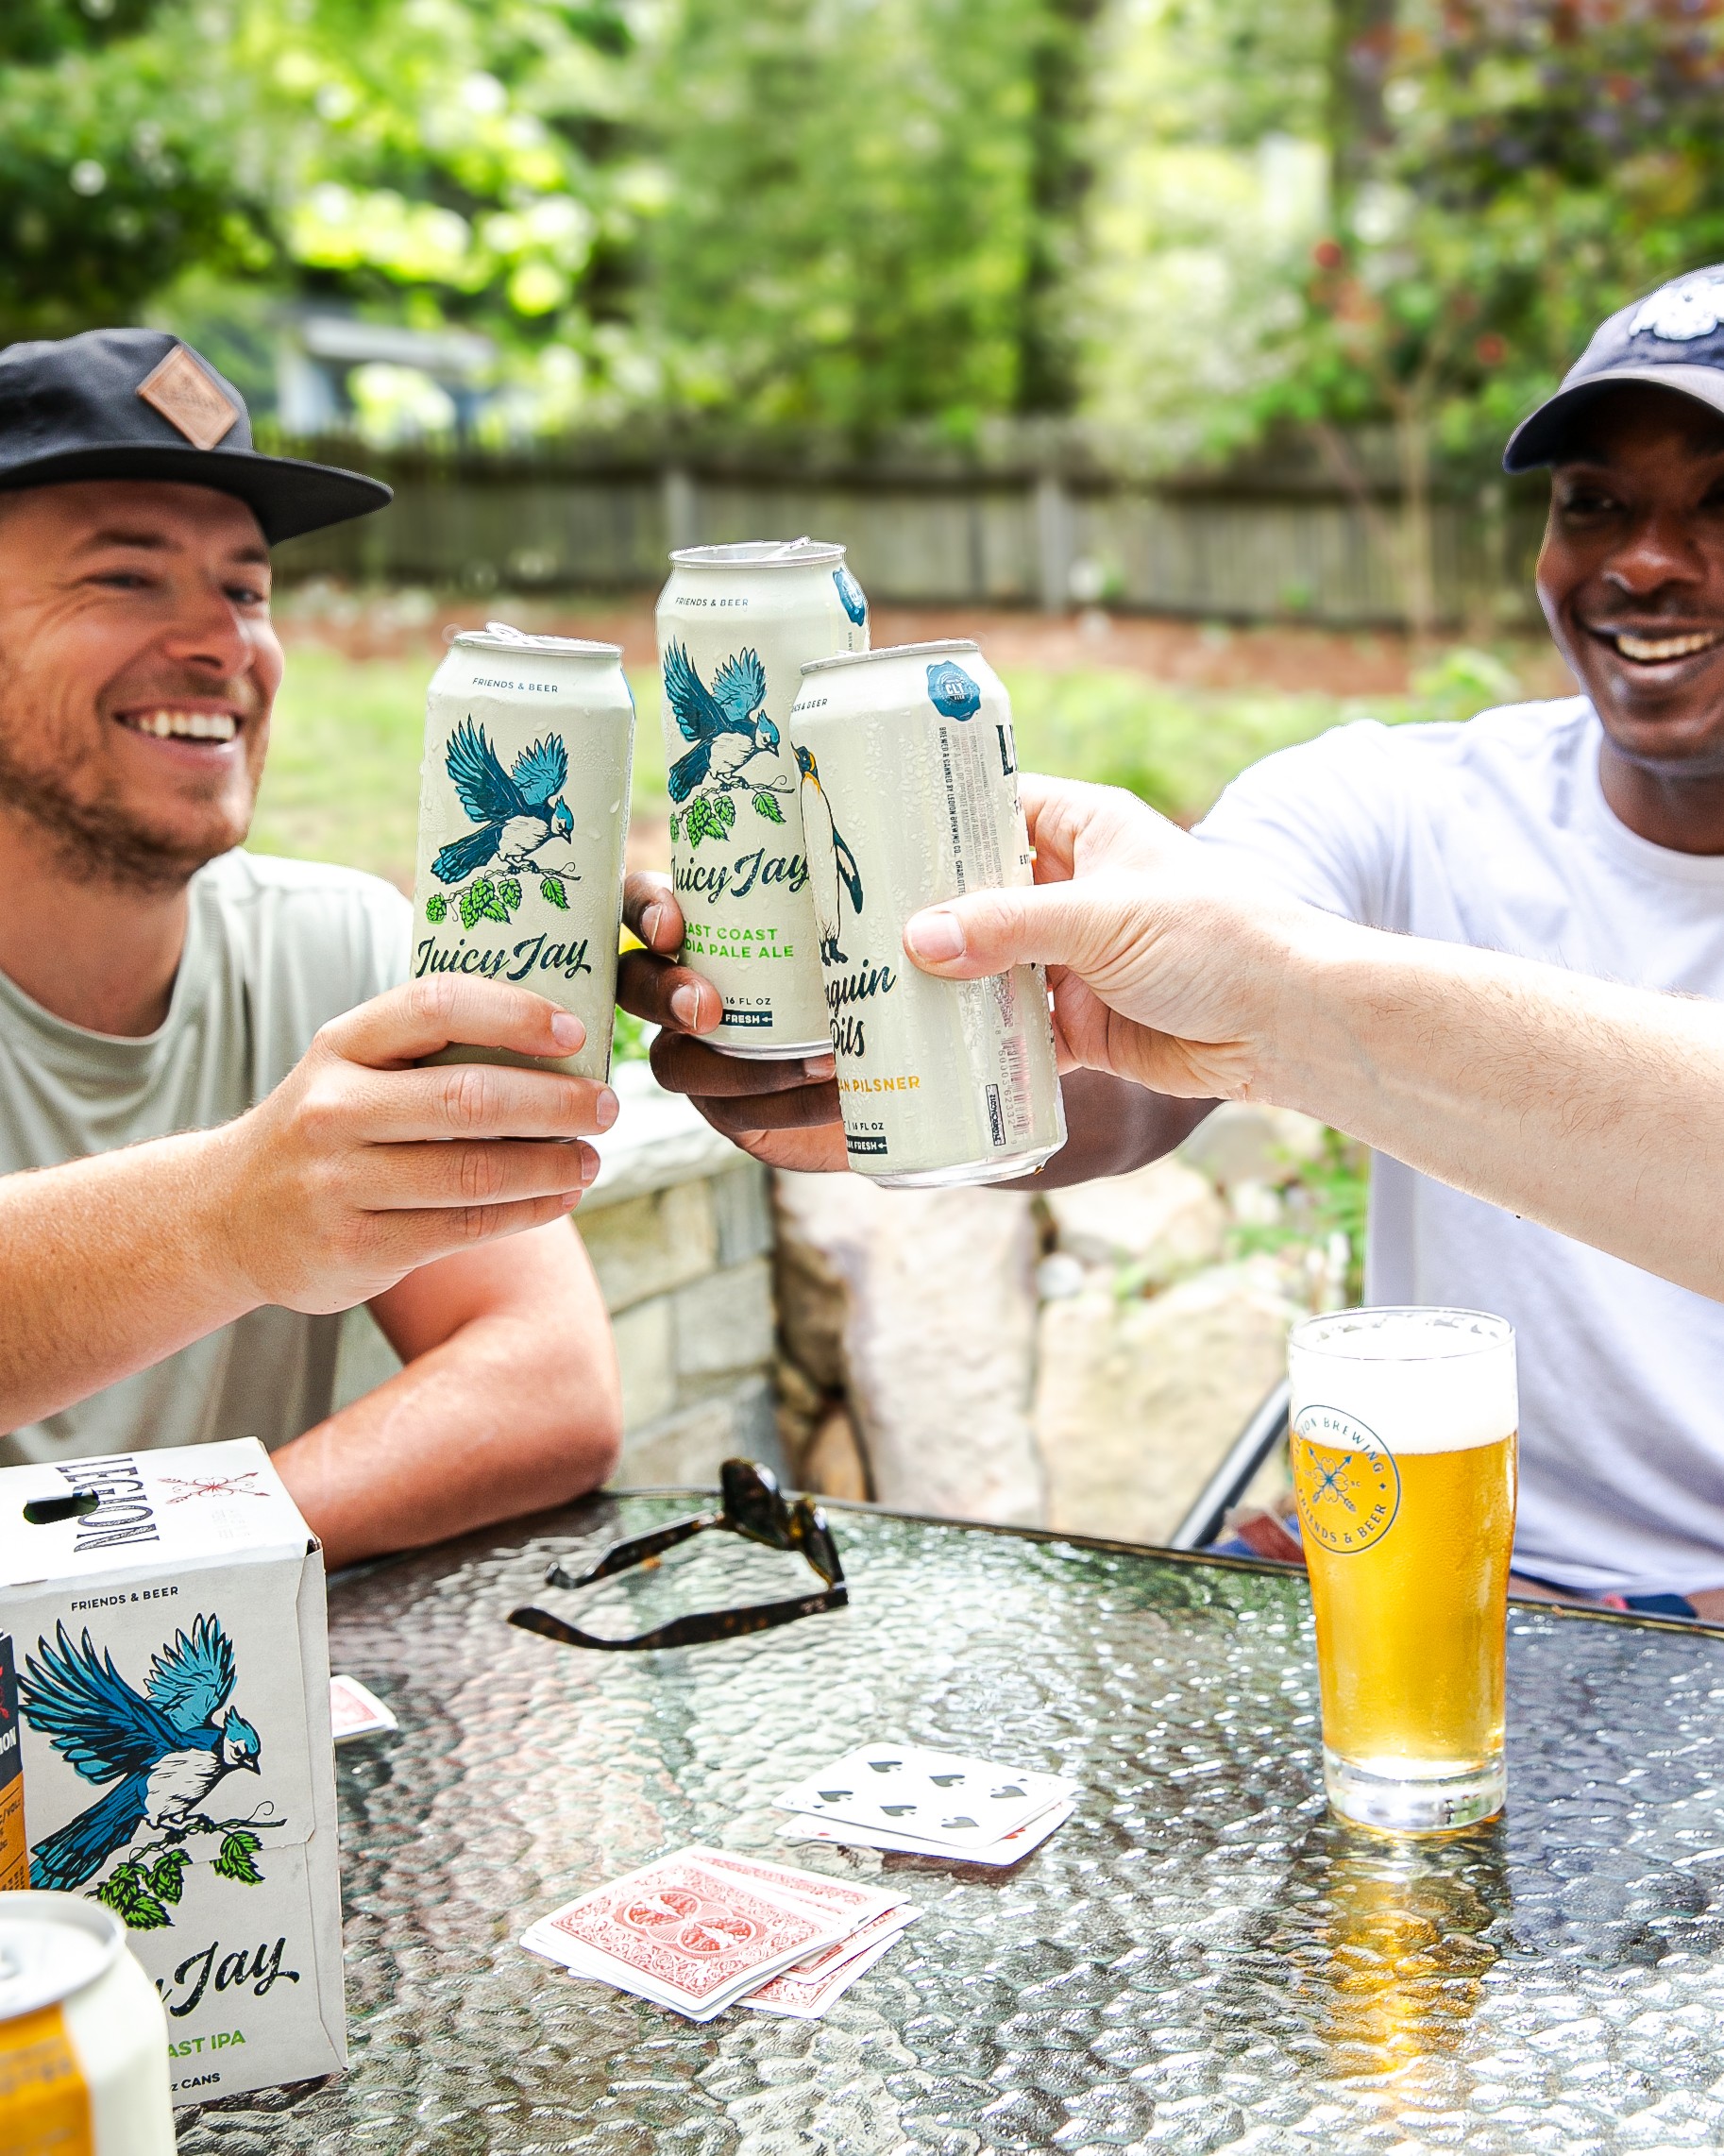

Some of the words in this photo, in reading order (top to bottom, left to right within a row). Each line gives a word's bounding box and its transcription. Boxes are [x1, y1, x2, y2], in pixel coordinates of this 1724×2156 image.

[675, 597, 707, 606] FRIENDS
[719, 598, 749, 606] BEER
[472, 677, 514, 689] FRIENDS
[517, 682, 525, 690] &
[529, 684, 559, 693] BEER
[945, 681, 965, 695] CLT
[806, 699, 828, 709] BEER
[939, 726, 949, 752] BREWED
[942, 758, 954, 784] CANNED
[946, 784, 955, 792] BY
[947, 793, 956, 815] LEGION
[950, 816, 960, 844] BREWING
[980, 819, 989, 840] DURING
[992, 846, 1002, 873] SURGEON
[730, 847, 811, 898] Jay
[717, 926, 778, 941] COAST
[414, 935, 511, 979] Juicy
[506, 932, 592, 981] Jay
[709, 943, 752, 959] PALE
[758, 945, 794, 959] ALE
[725, 996, 735, 1005] 16
[738, 997, 752, 1006] FL
[755, 997, 771, 1006] OZ
[725, 1013, 760, 1025] FRESH
[853, 1076, 921, 1093] PILSNER
[1004, 1089, 1016, 1125] 62332
[859, 1122, 870, 1130] FL
[870, 1122, 885, 1130] OZ
[854, 1141, 878, 1150] FRESH
[1324, 1417, 1385, 1473] BREWING
[56, 1457, 160, 1553] LEGION
[1298, 1488, 1338, 1543] FRIENDS
[1344, 1533, 1353, 1544] &
[1357, 1503, 1387, 1538] BEER
[71, 1594, 127, 1611] FRIENDS
[130, 1592, 140, 1603] &
[143, 1586, 179, 1601] BEER
[169, 1937, 300, 2017] Jay
[211, 2029, 246, 2050] IPA
[181, 2072, 221, 2089] CANS
